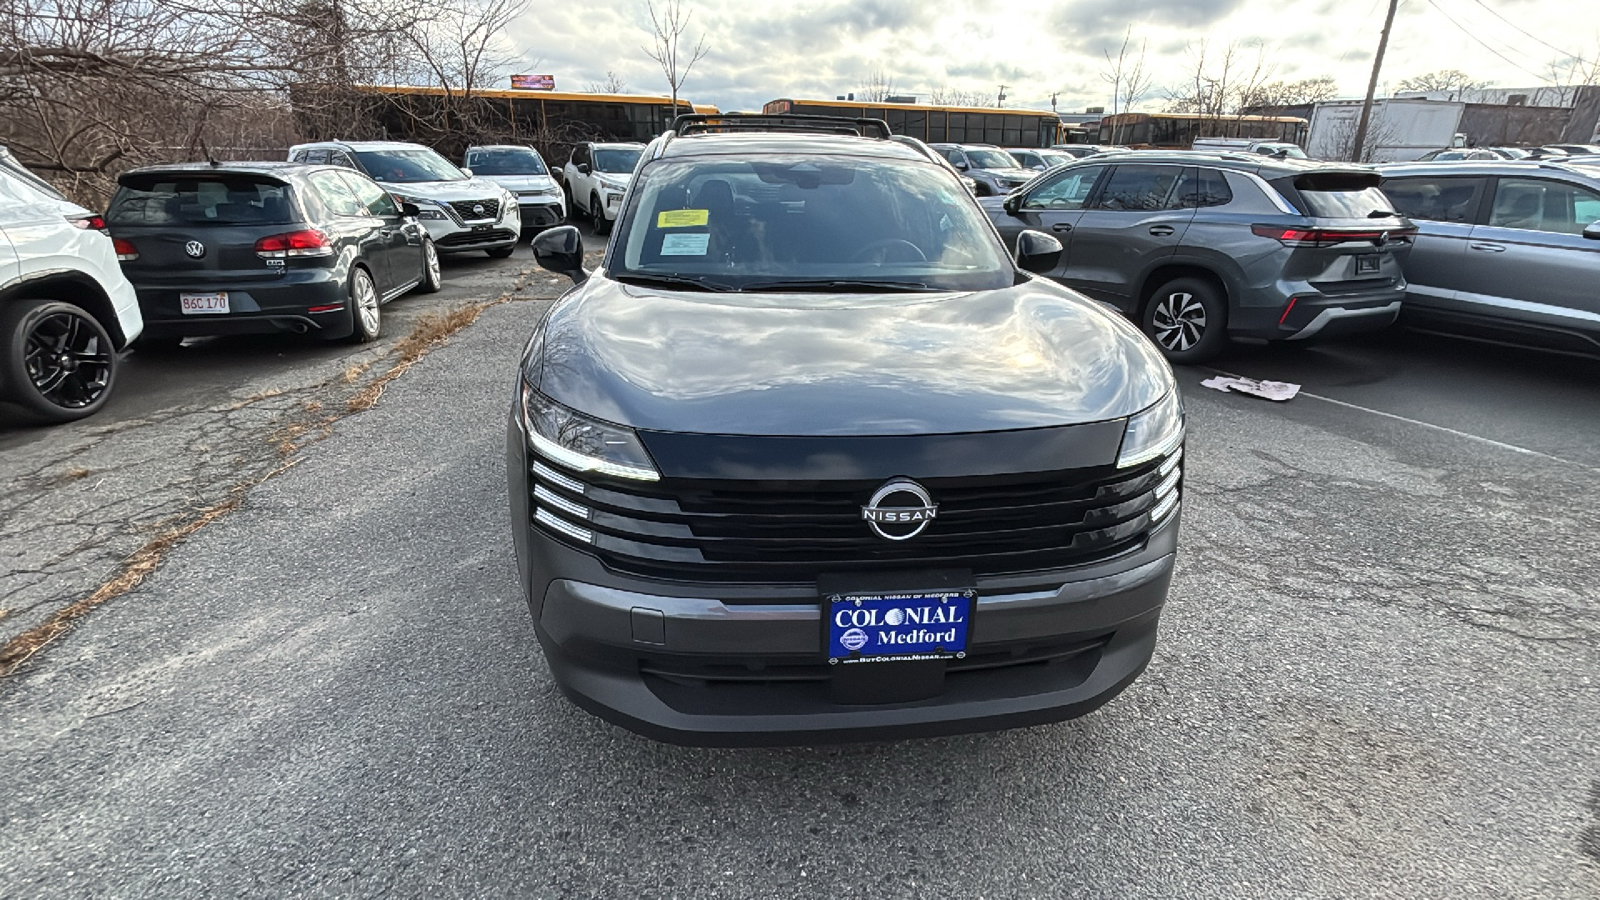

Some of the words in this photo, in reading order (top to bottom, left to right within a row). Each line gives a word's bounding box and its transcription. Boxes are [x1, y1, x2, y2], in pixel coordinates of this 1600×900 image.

[183, 298, 203, 309] 86C
[206, 298, 226, 308] 170
[864, 509, 936, 521] NISSAN
[835, 606, 963, 627] COLONIAL
[877, 628, 955, 645] Medford
